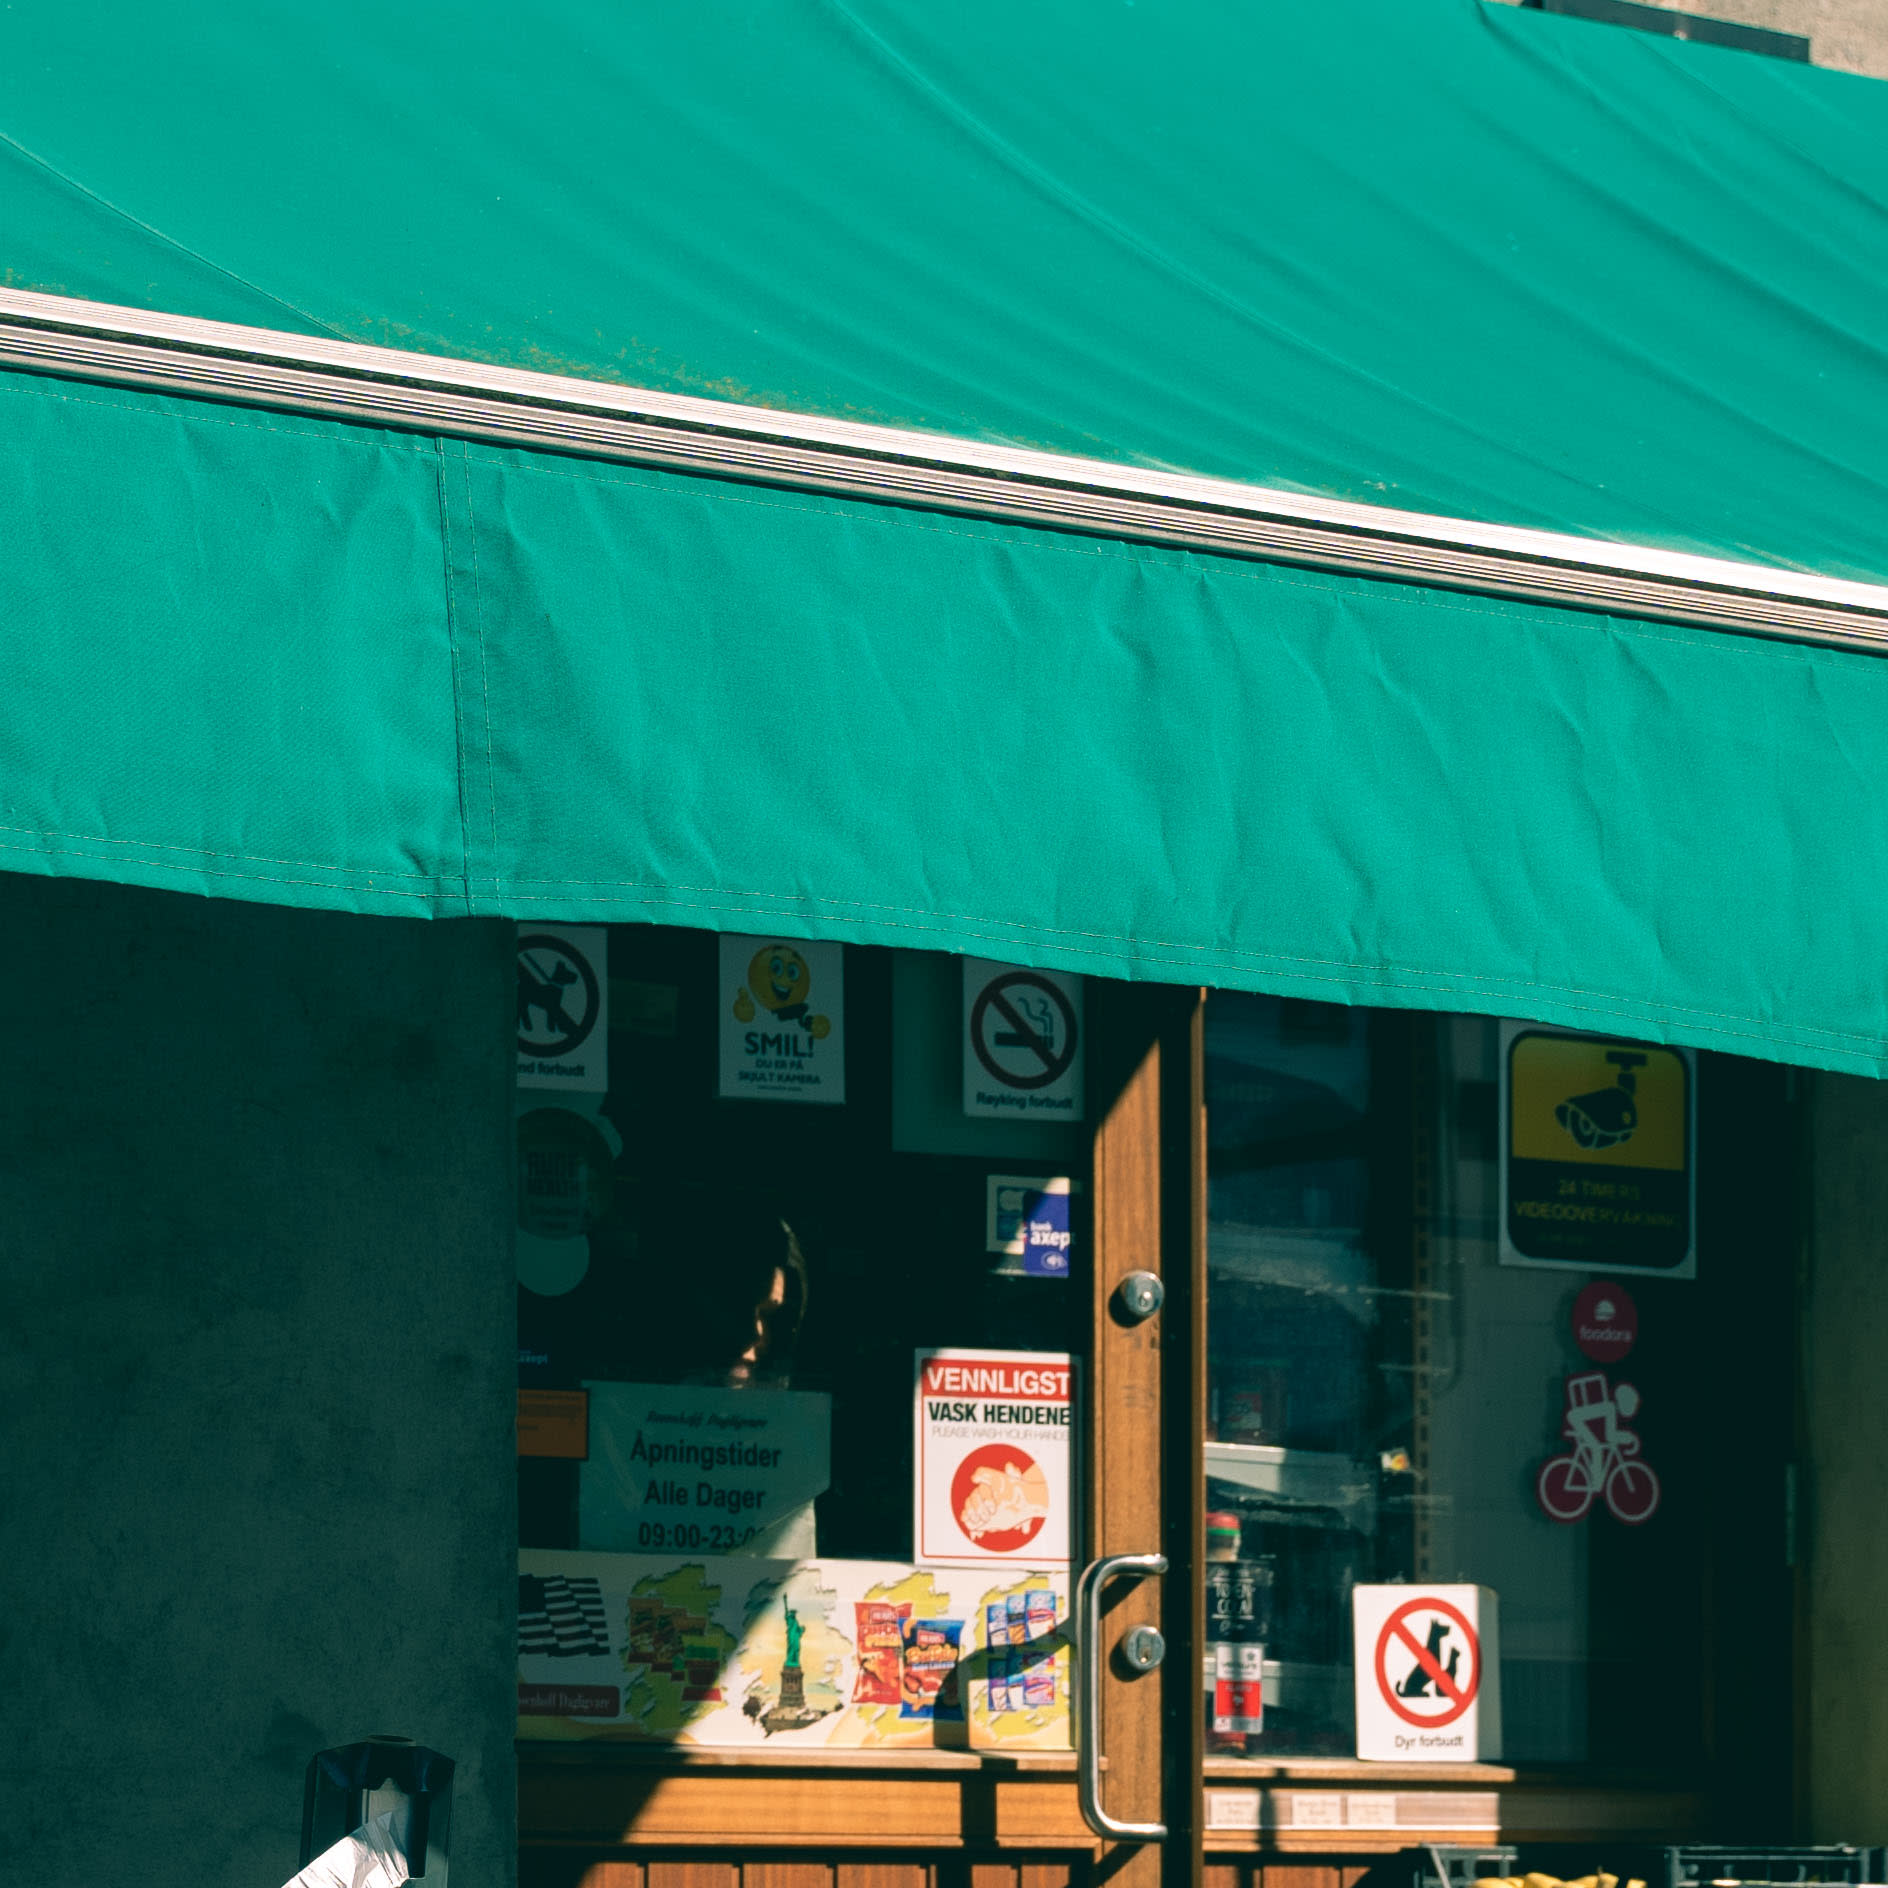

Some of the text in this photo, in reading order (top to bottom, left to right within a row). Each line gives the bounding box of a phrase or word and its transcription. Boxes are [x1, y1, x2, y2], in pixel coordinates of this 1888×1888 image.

[744, 1031, 815, 1058] SMIL!
[927, 1367, 1071, 1396] VENNLIGST
[928, 1402, 1073, 1426] VASK HENDENE
[629, 1429, 783, 1471] Åpningstider
[644, 1480, 768, 1514] Alle Dager
[1394, 1734, 1464, 1751] Dyr forbudt
